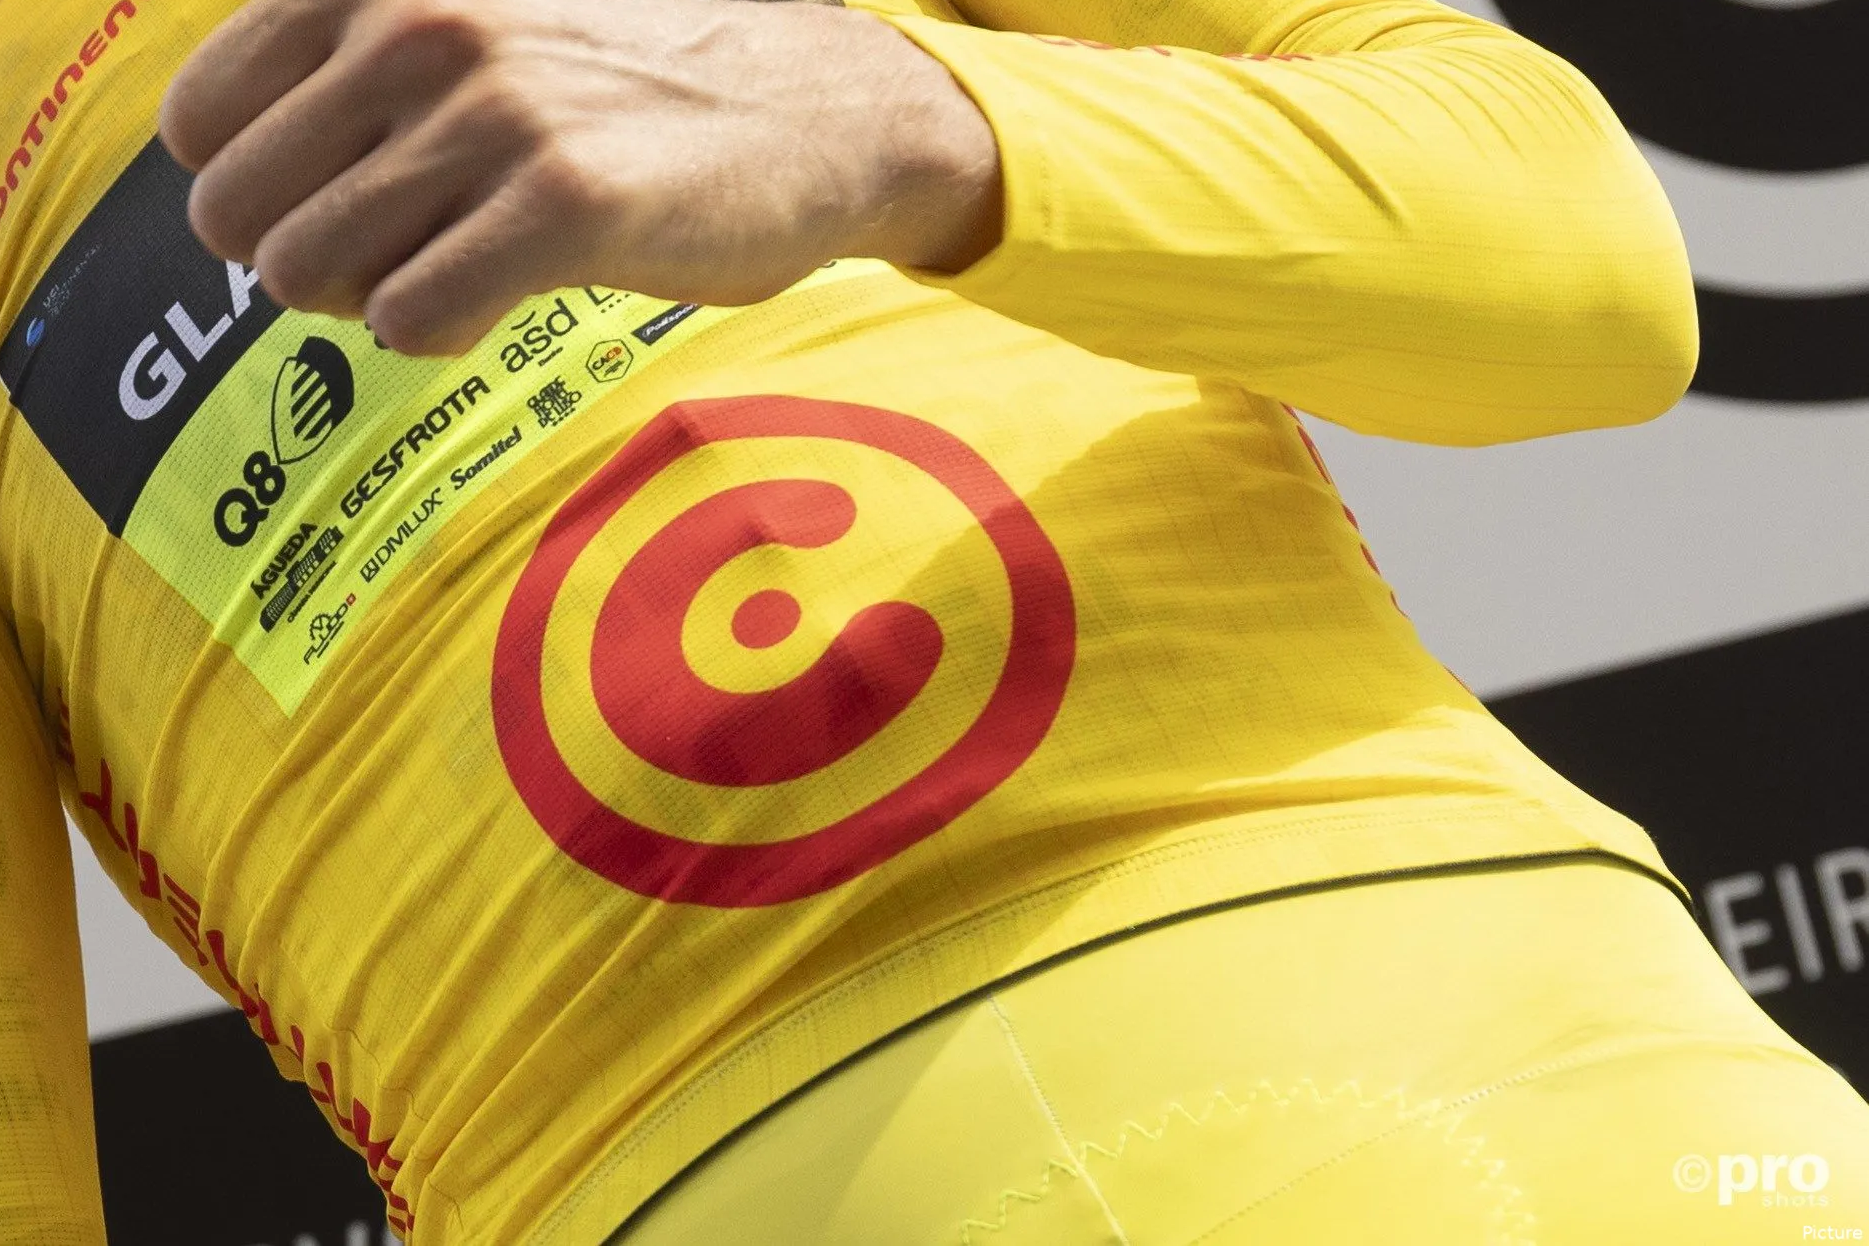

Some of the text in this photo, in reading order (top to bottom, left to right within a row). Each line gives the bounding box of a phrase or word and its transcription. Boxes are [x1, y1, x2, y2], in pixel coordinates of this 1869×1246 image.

[341, 375, 490, 519] GESFROTA
[451, 425, 522, 490] Somitel
[214, 450, 286, 547] Q8
